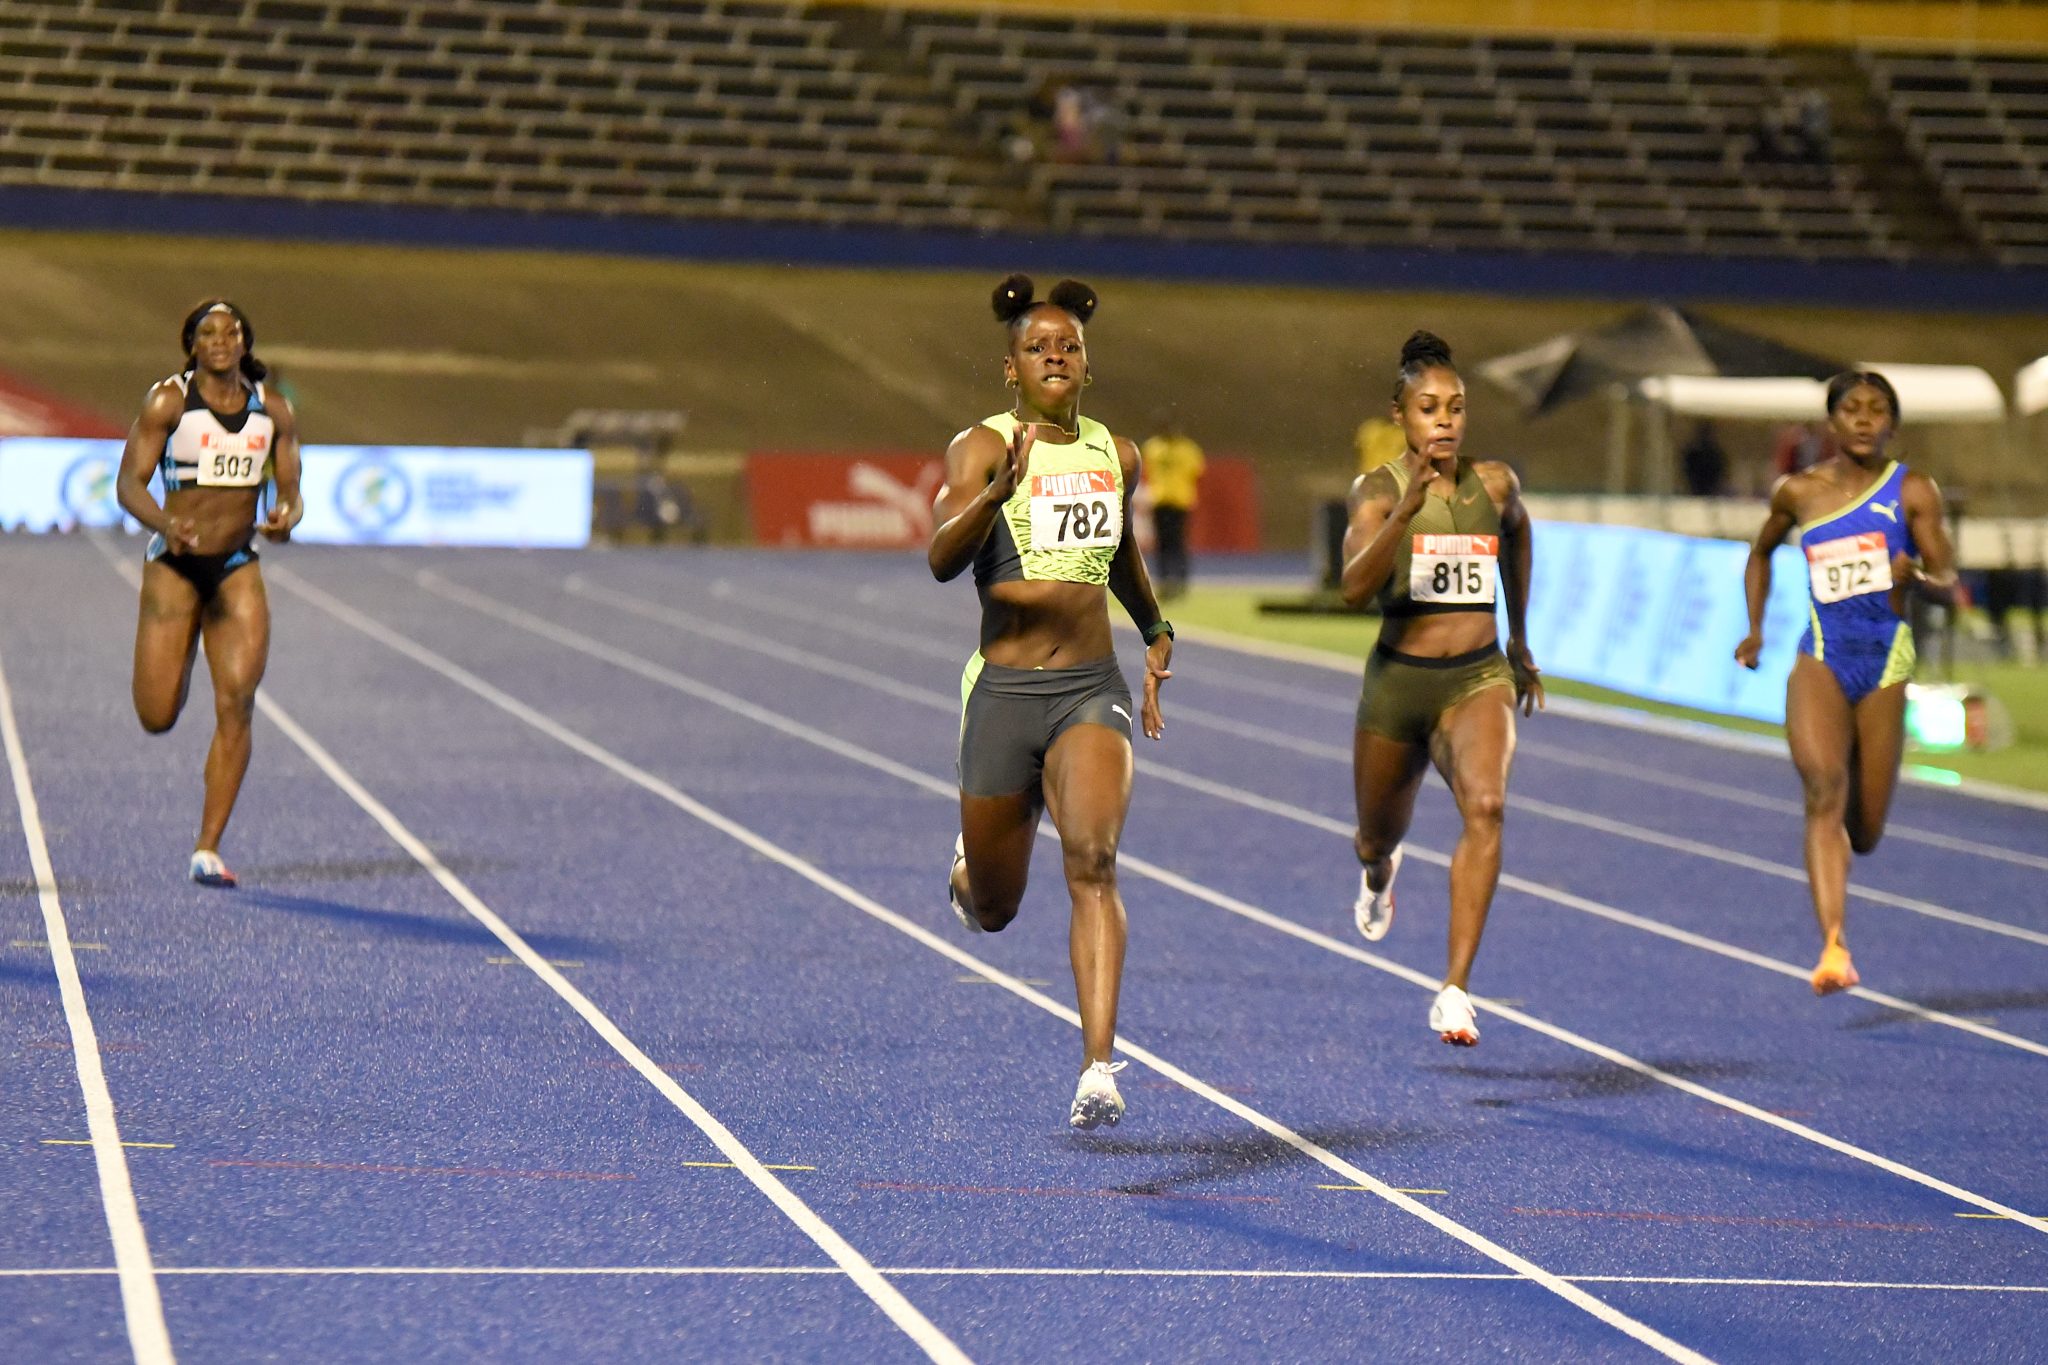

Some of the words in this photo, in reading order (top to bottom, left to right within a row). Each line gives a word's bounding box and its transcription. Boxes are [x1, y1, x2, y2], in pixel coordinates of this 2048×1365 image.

[213, 454, 253, 477] 503
[1041, 473, 1092, 496] PUMA
[1053, 501, 1112, 542] 782
[1432, 562, 1482, 594] 815
[1828, 560, 1872, 592] 972
